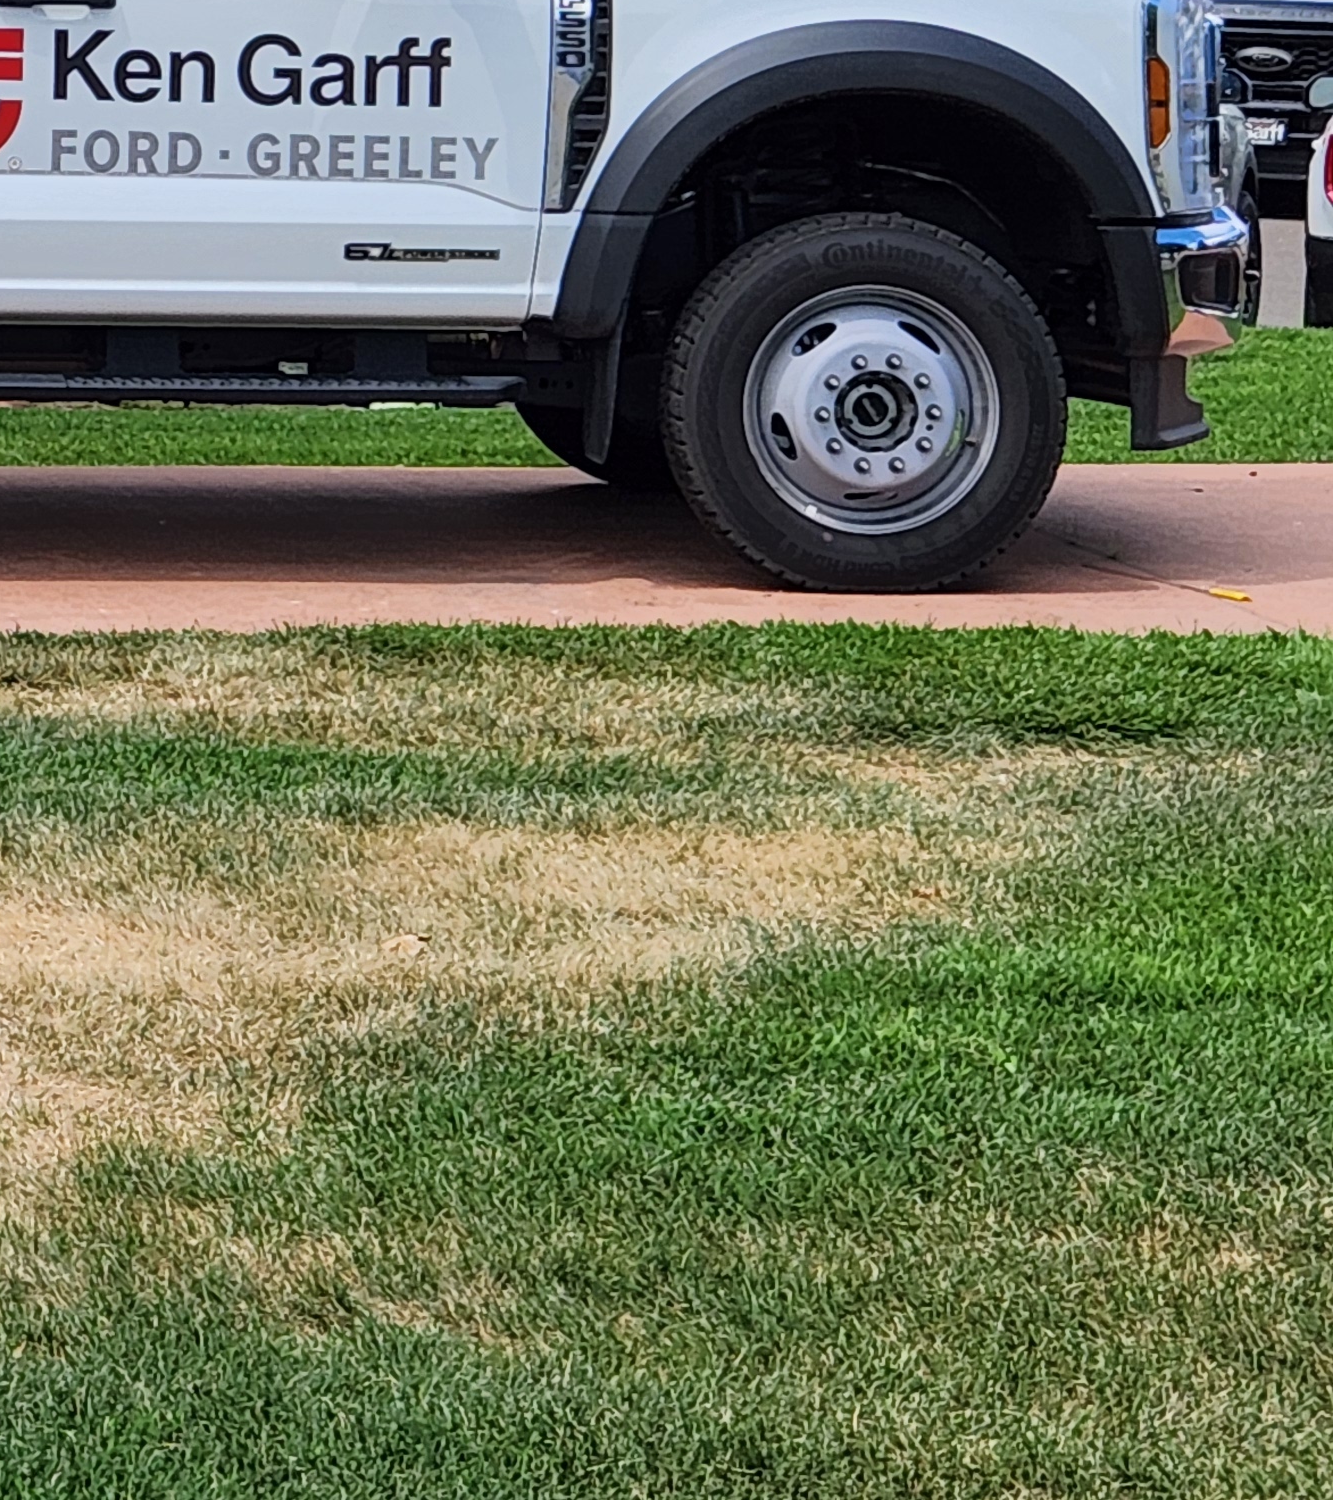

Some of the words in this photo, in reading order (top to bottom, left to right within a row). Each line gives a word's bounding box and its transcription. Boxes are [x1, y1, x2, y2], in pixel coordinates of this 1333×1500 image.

[52, 28, 216, 104] Ken
[237, 33, 452, 108] Garff
[50, 129, 203, 175] FORD
[246, 133, 500, 181] GREELEY
[822, 239, 969, 283] Continental
